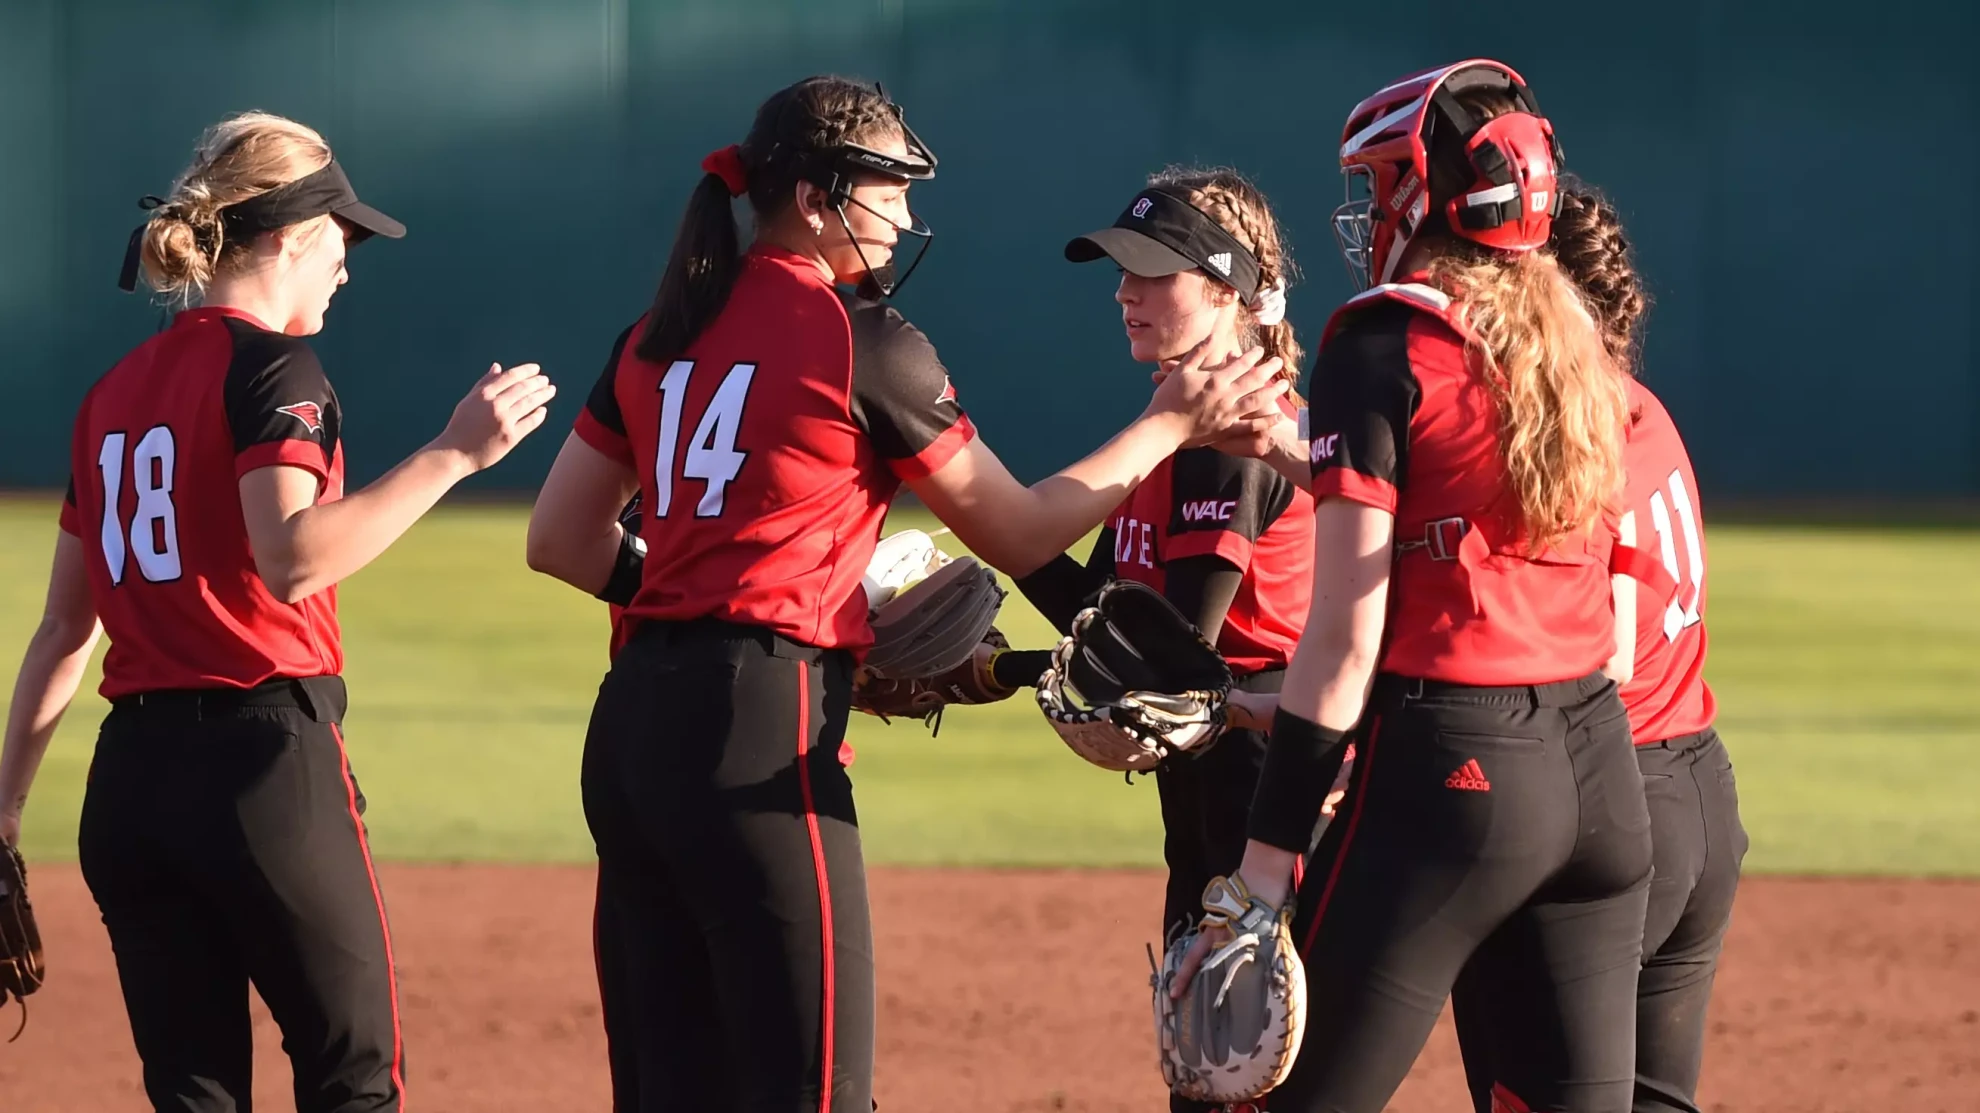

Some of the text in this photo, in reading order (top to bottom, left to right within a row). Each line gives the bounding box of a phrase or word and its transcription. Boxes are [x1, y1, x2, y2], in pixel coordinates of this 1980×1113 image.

[1390, 175, 1420, 211] Wilson
[656, 360, 757, 518] 14
[98, 425, 182, 584] 18
[1183, 501, 1236, 521] WAC
[1649, 467, 1703, 644] 11
[1445, 777, 1490, 791] adidas
